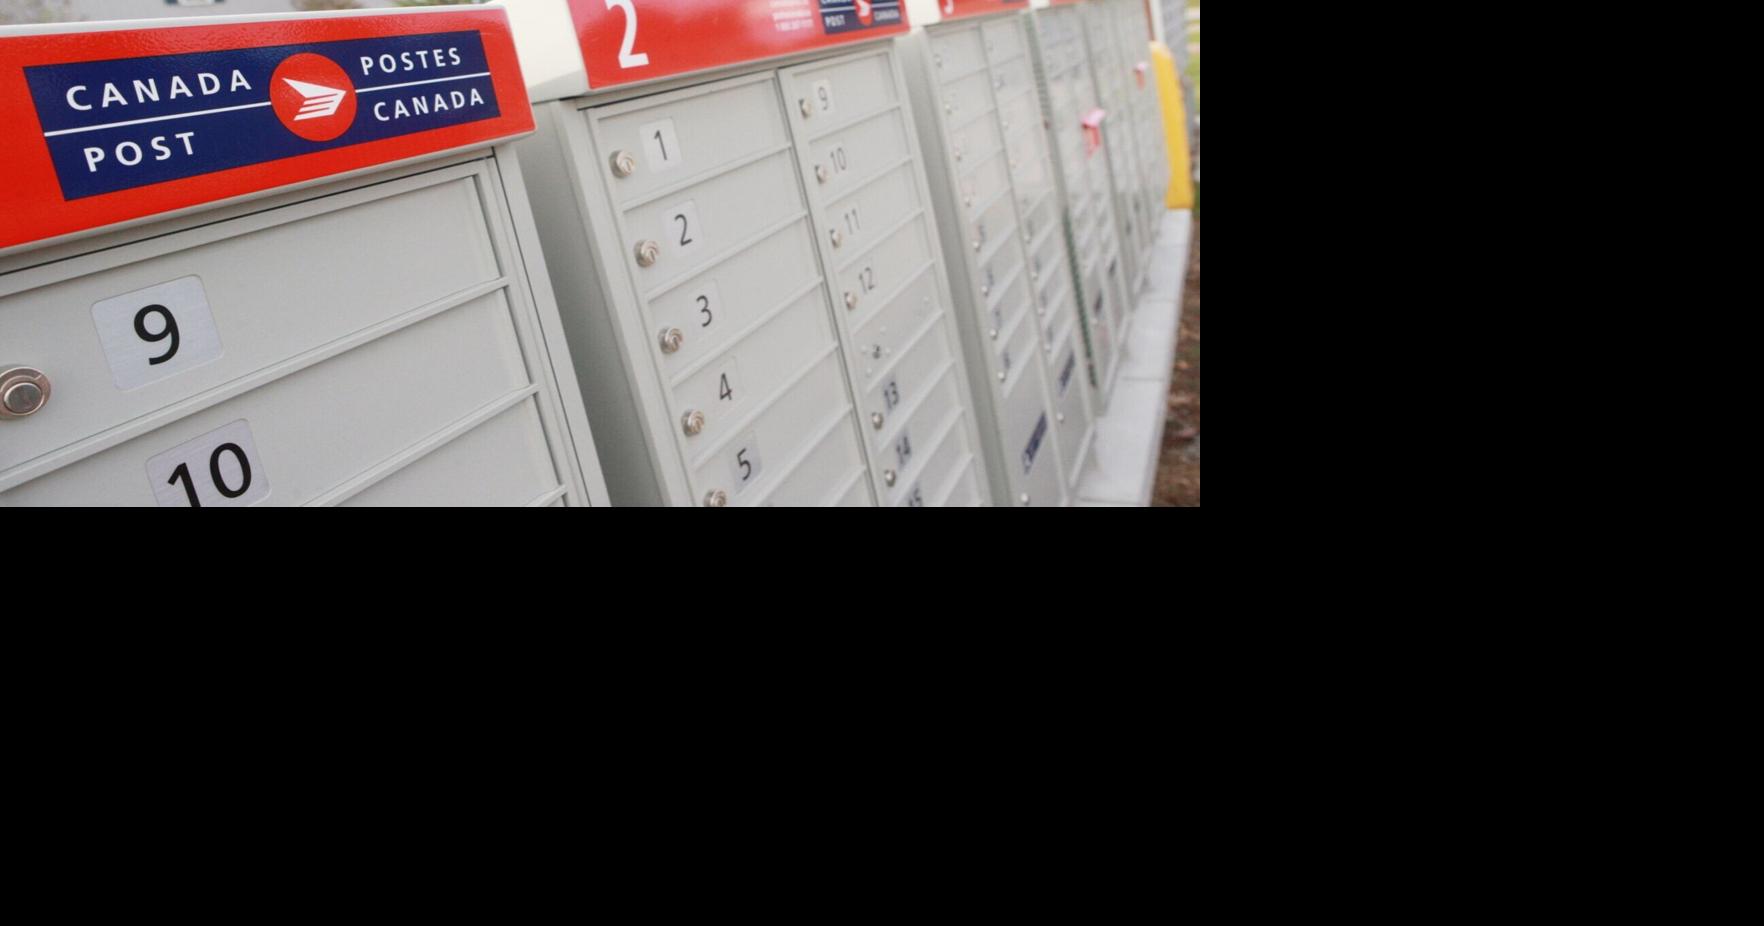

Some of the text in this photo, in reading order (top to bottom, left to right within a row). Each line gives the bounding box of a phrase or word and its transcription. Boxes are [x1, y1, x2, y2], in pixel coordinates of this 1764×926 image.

[606, 0, 649, 69] 2
[824, 14, 845, 28] POST
[361, 47, 462, 76] POSTES
[66, 69, 252, 111] CANADA
[373, 88, 485, 122] CANADA
[818, 86, 829, 111] 9
[83, 131, 196, 173] POST
[653, 129, 668, 161] 1
[830, 147, 847, 174] 10
[674, 213, 693, 246] 2
[844, 208, 860, 235] 11
[859, 266, 876, 295] 12
[696, 295, 712, 327] 3
[134, 304, 180, 365] 9
[719, 372, 732, 401] 4
[167, 442, 252, 507] 10
[736, 448, 752, 481] 5
